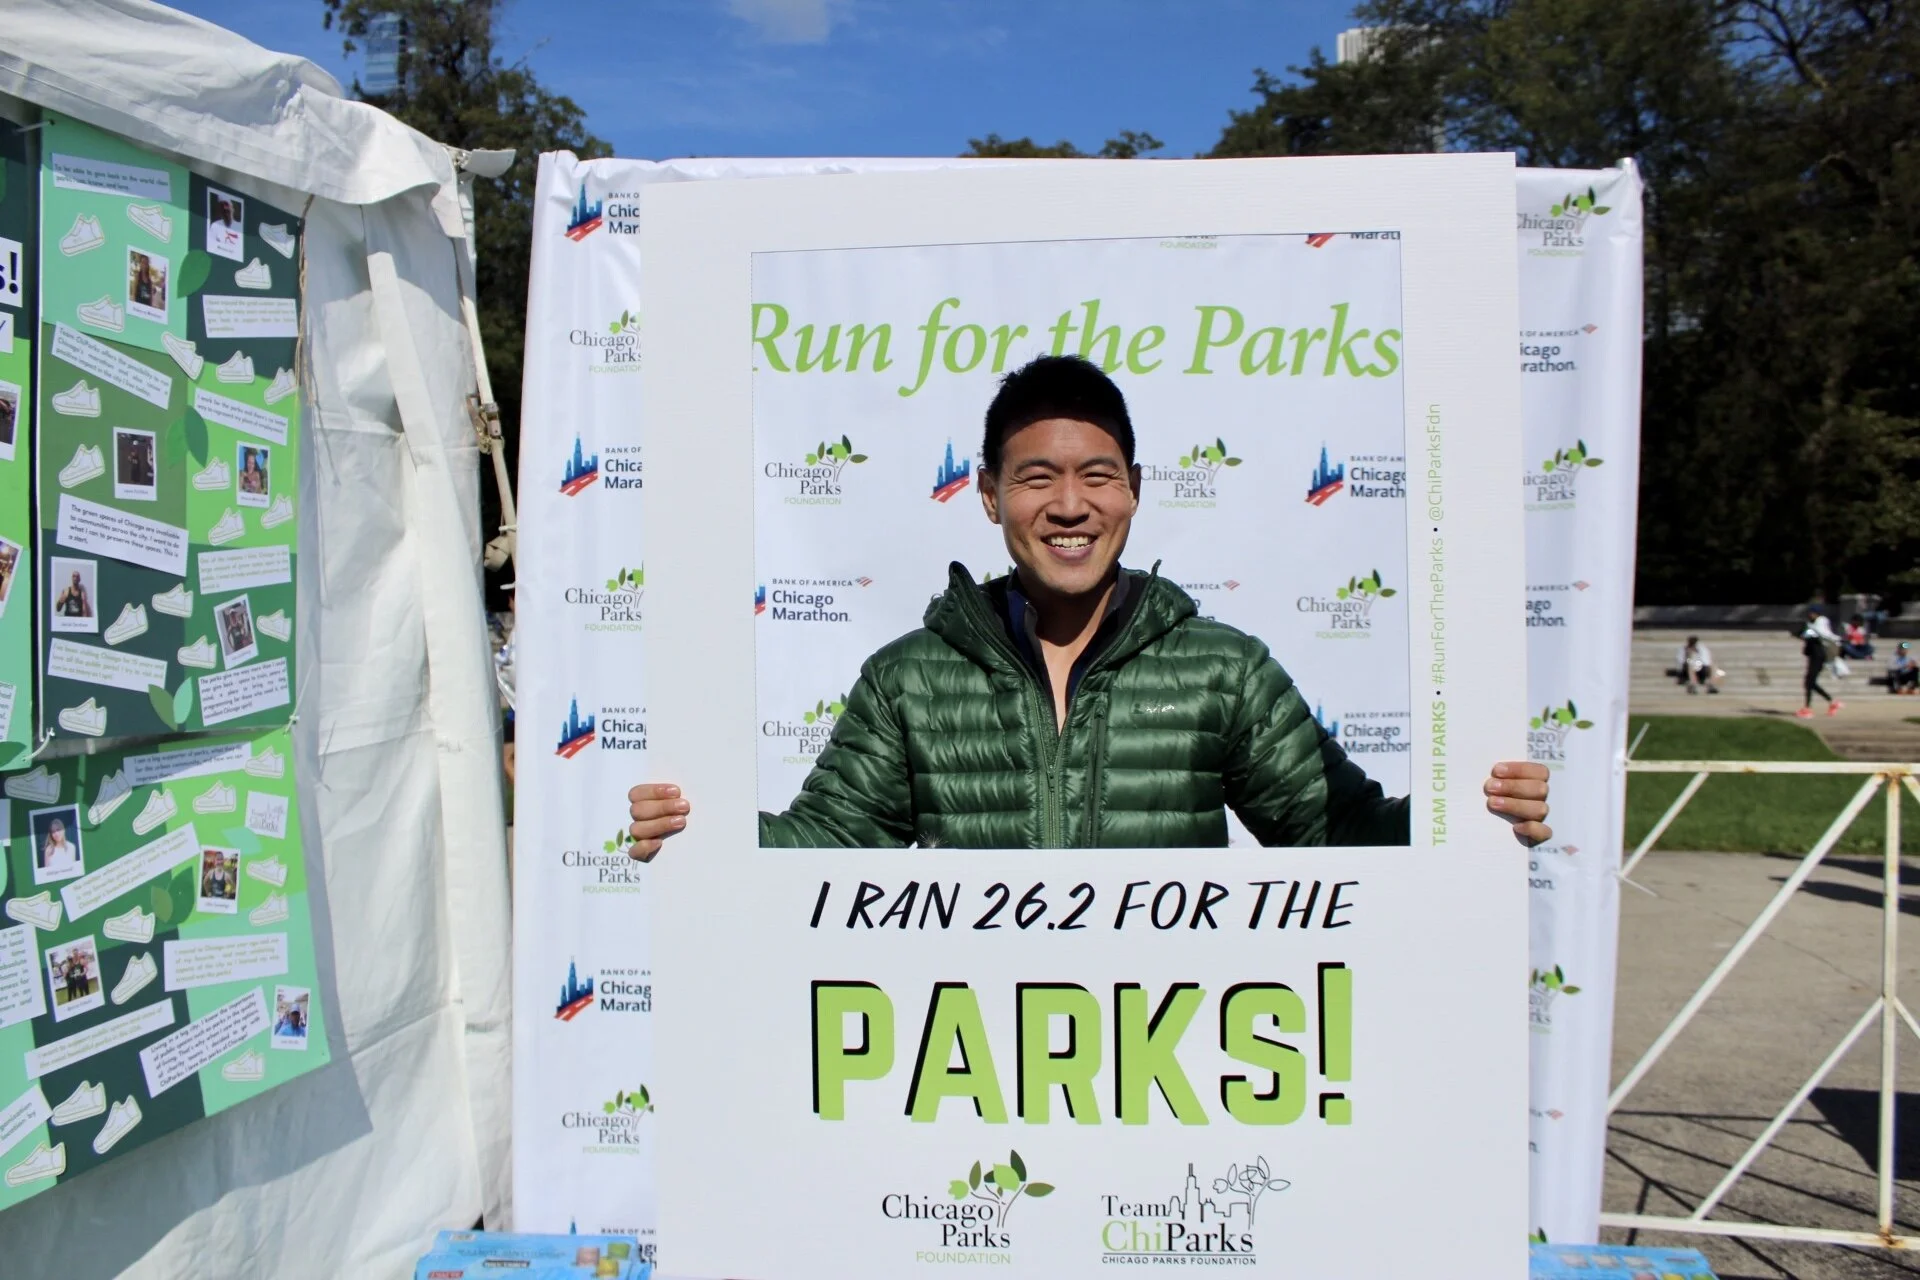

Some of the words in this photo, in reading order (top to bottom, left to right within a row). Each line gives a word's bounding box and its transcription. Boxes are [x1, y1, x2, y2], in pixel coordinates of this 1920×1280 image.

[1160, 242, 1218, 250] FOUNDATION
[1542, 232, 1584, 248] Parks
[569, 330, 634, 351] Chicago
[752, 303, 893, 374] Run
[898, 298, 1027, 398] for
[1049, 299, 1167, 375] the
[1183, 302, 1401, 378] Parks
[764, 462, 832, 482] Chicago
[1427, 403, 1442, 521] @ChiParksFdn
[1141, 465, 1207, 486] Chicago
[800, 480, 842, 496] Parks
[1174, 483, 1216, 498] Parks
[1536, 485, 1576, 502] Parks
[784, 497, 842, 505] FOUNDATION
[1158, 500, 1216, 508] FOUNDATION
[72, 504, 80, 512] The
[100, 514, 116, 523] spaces
[124, 518, 144, 530] Chicago
[565, 587, 633, 608] Chicago
[772, 590, 834, 608] Chicago
[1296, 596, 1363, 616] Chicago
[600, 607, 642, 622] Parks
[1331, 614, 1372, 629] Parks
[1430, 538, 1445, 685] #RunForTheParks
[584, 624, 642, 632] FOUNDATION
[762, 720, 832, 742] Chicago
[1344, 724, 1400, 740] Chicago
[1432, 700, 1446, 752] PARKS
[1432, 753, 1446, 793] CHI
[1432, 794, 1446, 846] TEAM
[562, 851, 630, 873] Chicago
[598, 868, 640, 884] Parks
[809, 880, 831, 928] I
[846, 880, 960, 930] RAN
[972, 881, 1096, 930] 26.2
[1113, 880, 1230, 930] FOR
[1247, 880, 1360, 930] THE
[150, 1042, 167, 1054] Living
[811, 962, 1352, 1126] PARKS!
[562, 1112, 630, 1133] Chicago
[598, 1129, 640, 1145] Parks
[882, 1194, 994, 1228] Chicago
[1101, 1195, 1169, 1218] Team
[940, 1223, 1010, 1248] Parks
[1101, 1220, 1254, 1253] ChiParks
[916, 1251, 1011, 1264] FOUNDATION
[1102, 1256, 1149, 1265] CHICAGO
[1152, 1256, 1186, 1265] PARKS
[1190, 1256, 1257, 1266] FOUNDATION
